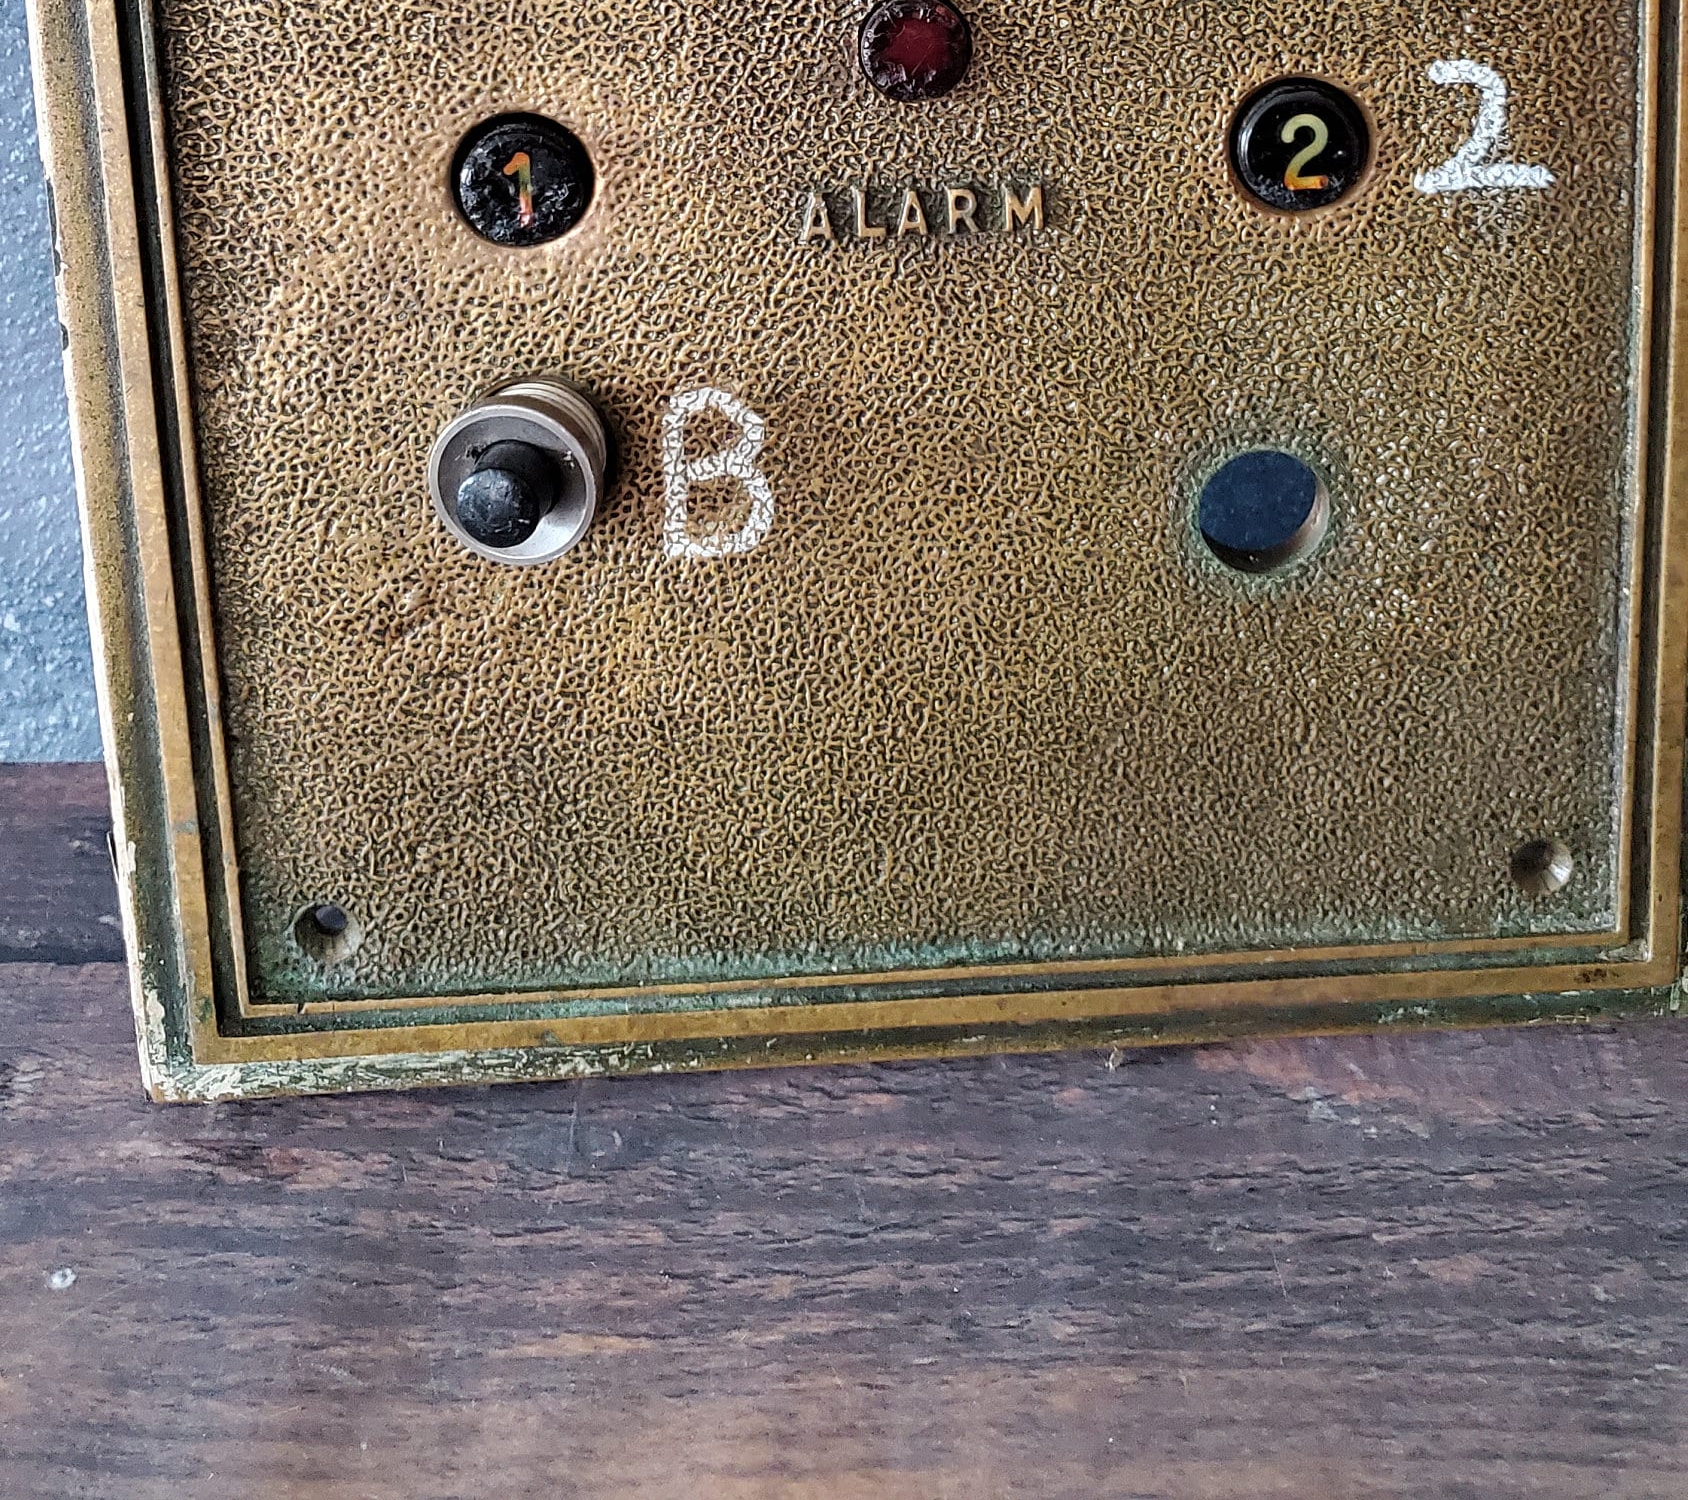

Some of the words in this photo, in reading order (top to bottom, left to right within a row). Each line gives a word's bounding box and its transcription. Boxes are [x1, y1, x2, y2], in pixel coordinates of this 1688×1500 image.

[1281, 113, 1329, 191] 2
[1414, 58, 1556, 196] 2
[502, 151, 535, 228] 1
[802, 184, 1044, 241] ALARM
[661, 386, 775, 560] B
